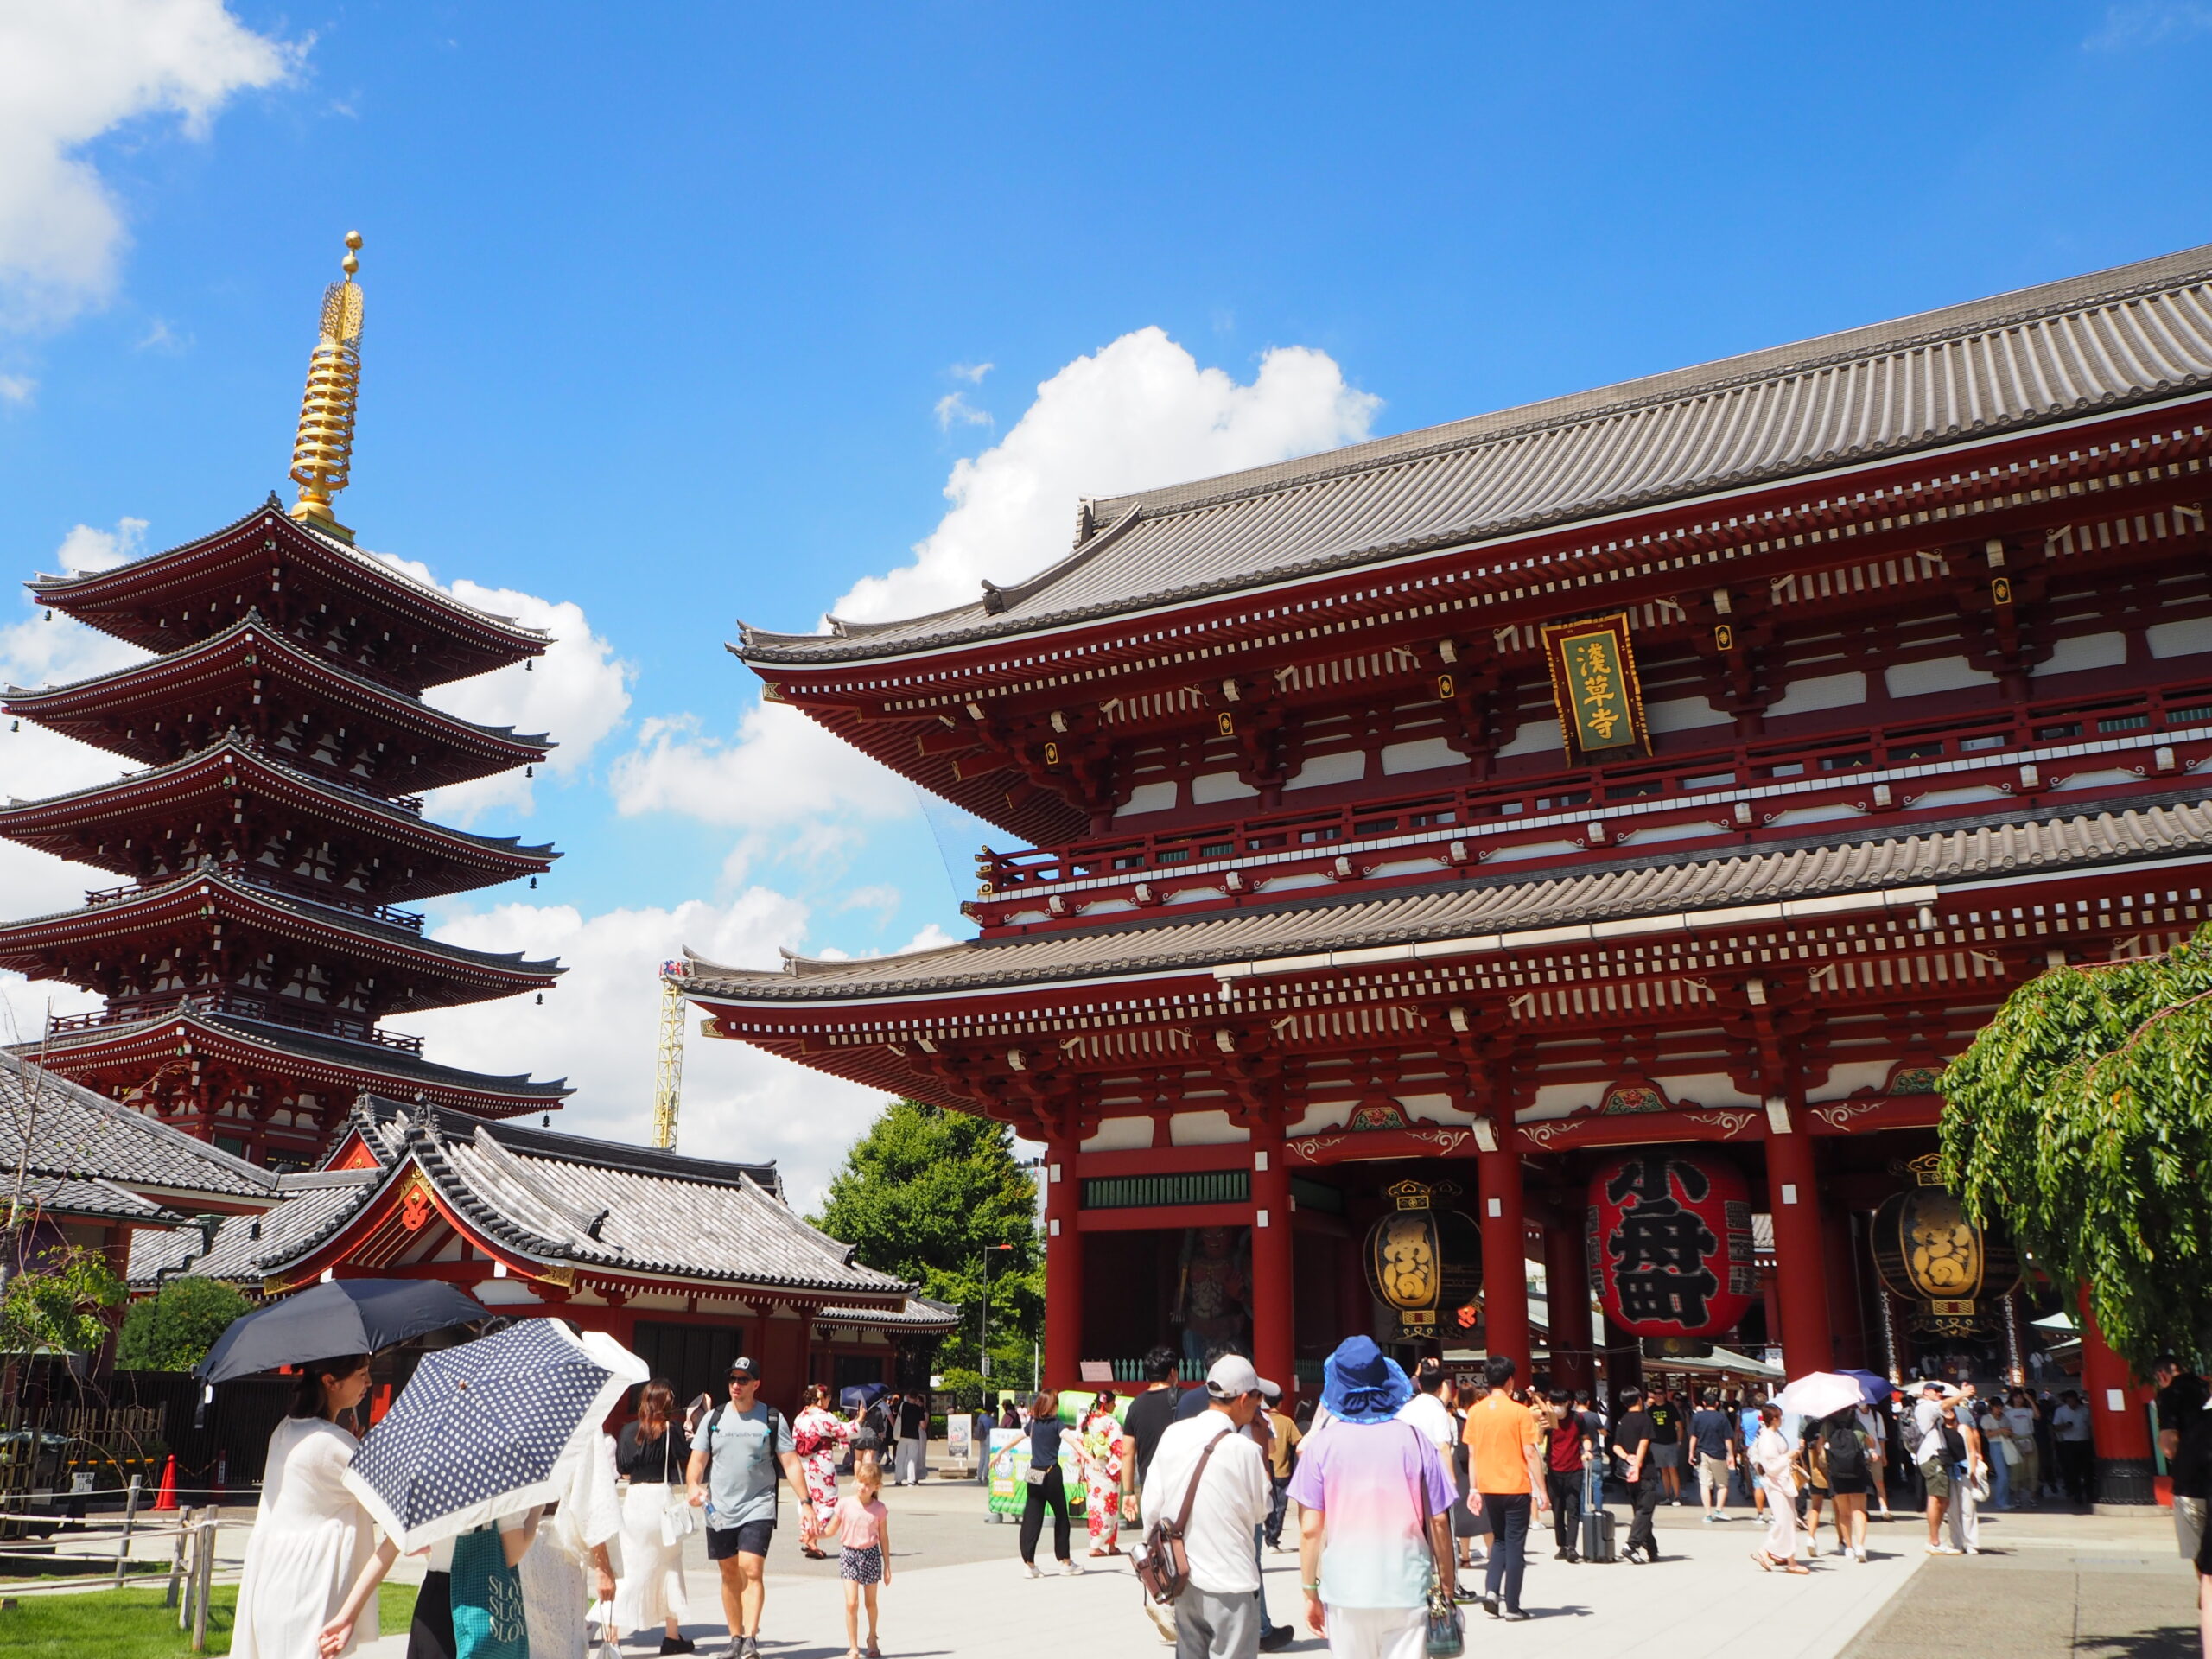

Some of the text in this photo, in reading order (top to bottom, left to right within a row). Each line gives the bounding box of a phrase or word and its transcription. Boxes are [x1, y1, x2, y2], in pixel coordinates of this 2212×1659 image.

[1605, 1155, 1719, 1329] 小舟町
[489, 1615, 526, 1643] SLOY
